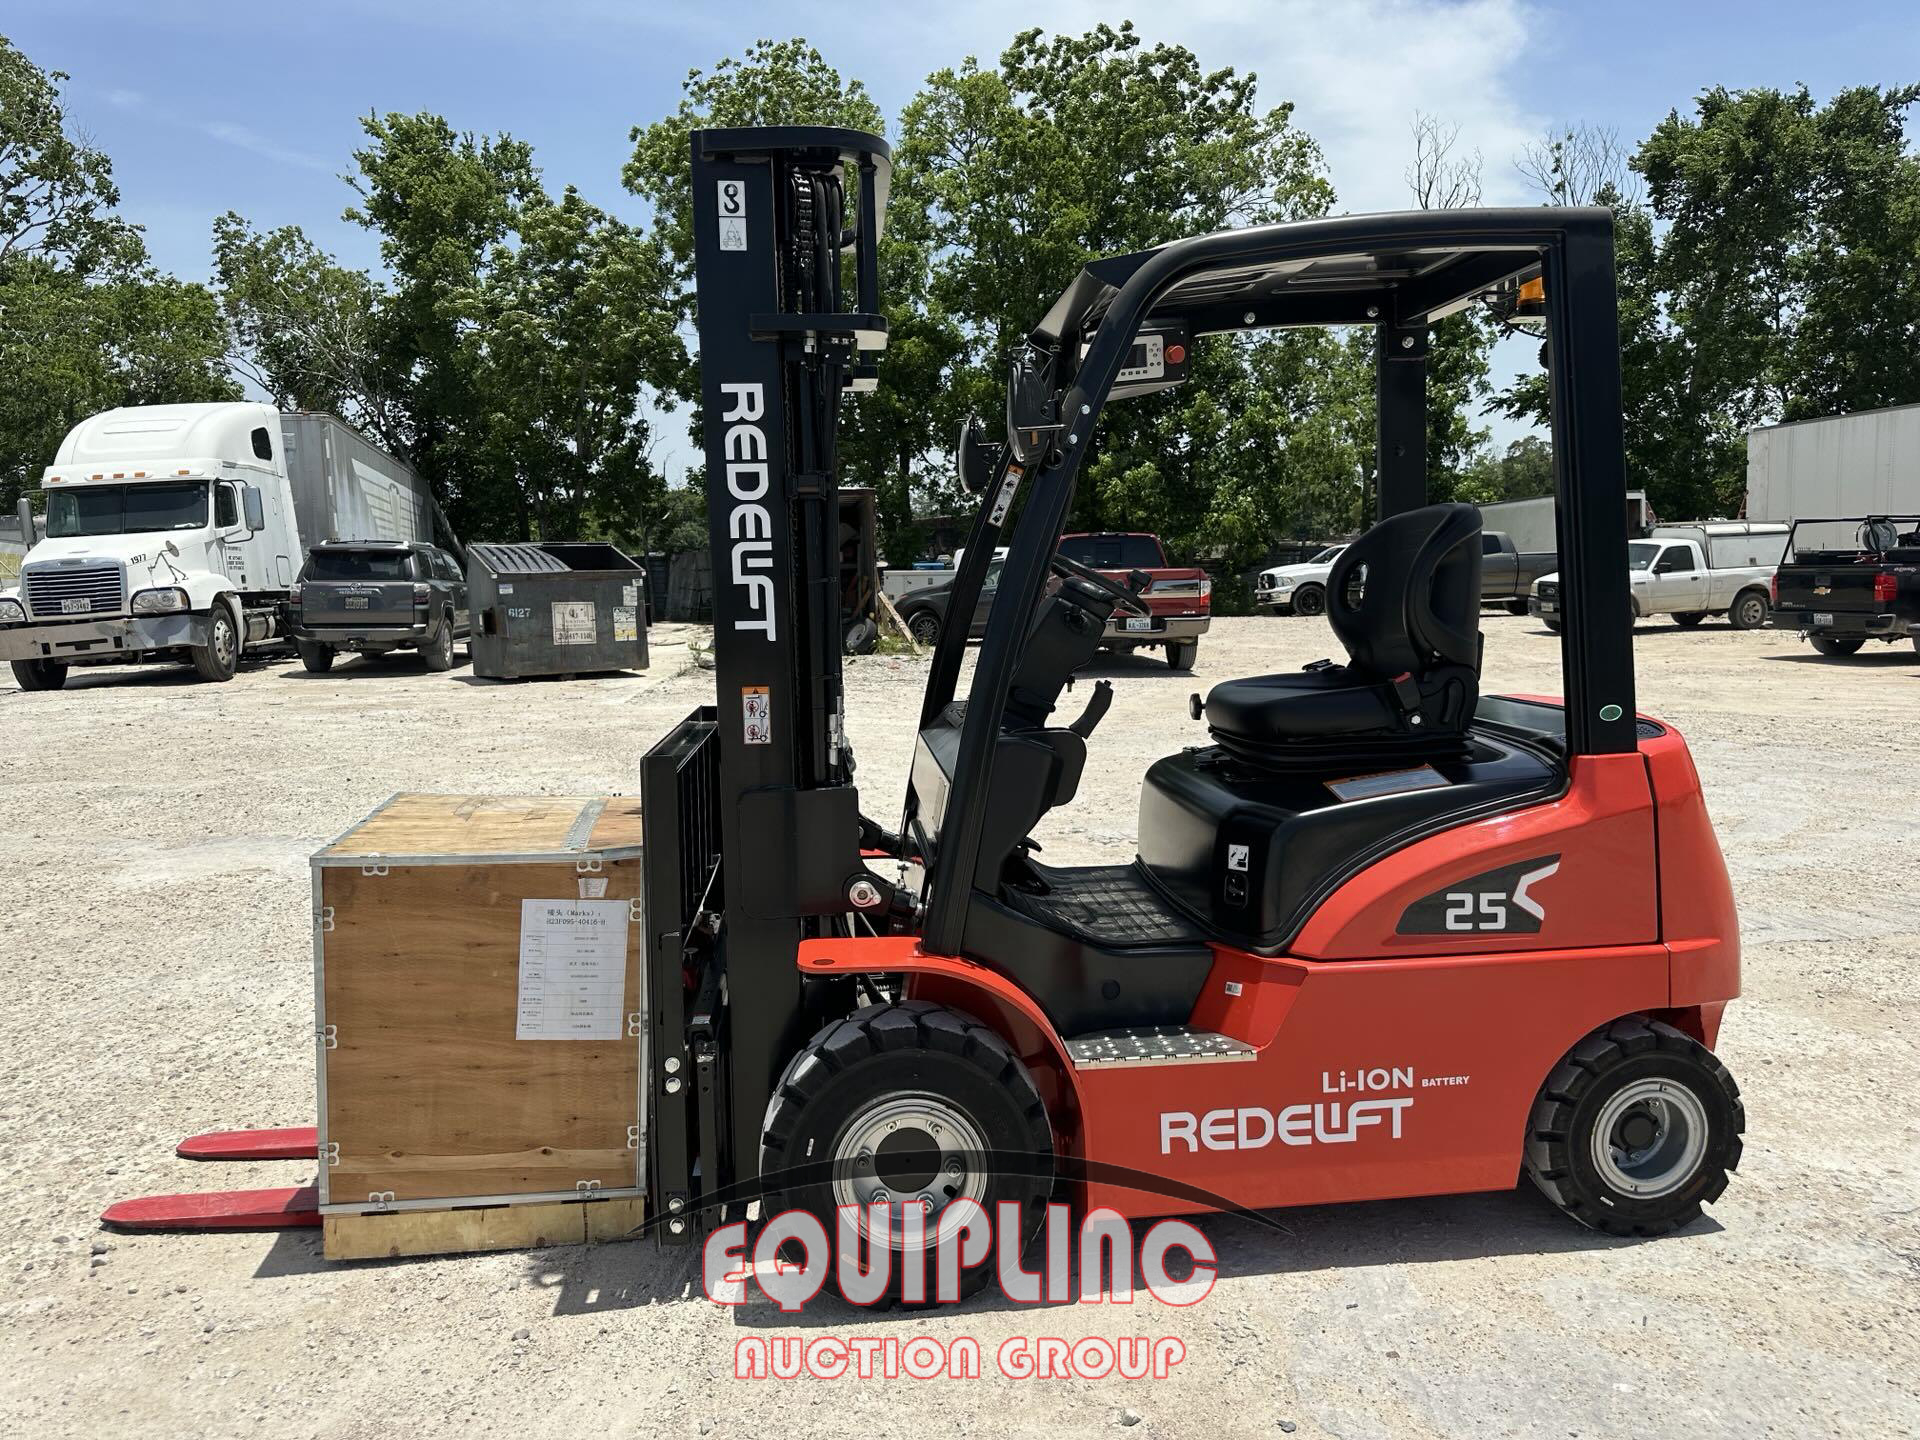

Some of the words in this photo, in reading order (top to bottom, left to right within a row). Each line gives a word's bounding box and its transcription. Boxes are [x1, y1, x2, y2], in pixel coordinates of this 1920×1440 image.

[720, 383, 777, 642] REDELIFT
[130, 553, 147, 565] 1977
[508, 608, 531, 618] 6127
[1445, 892, 1507, 931] 25
[1322, 1067, 1414, 1093] Li-ION
[1421, 1075, 1470, 1087] BATTERY
[1160, 1097, 1414, 1155] REDELIFT
